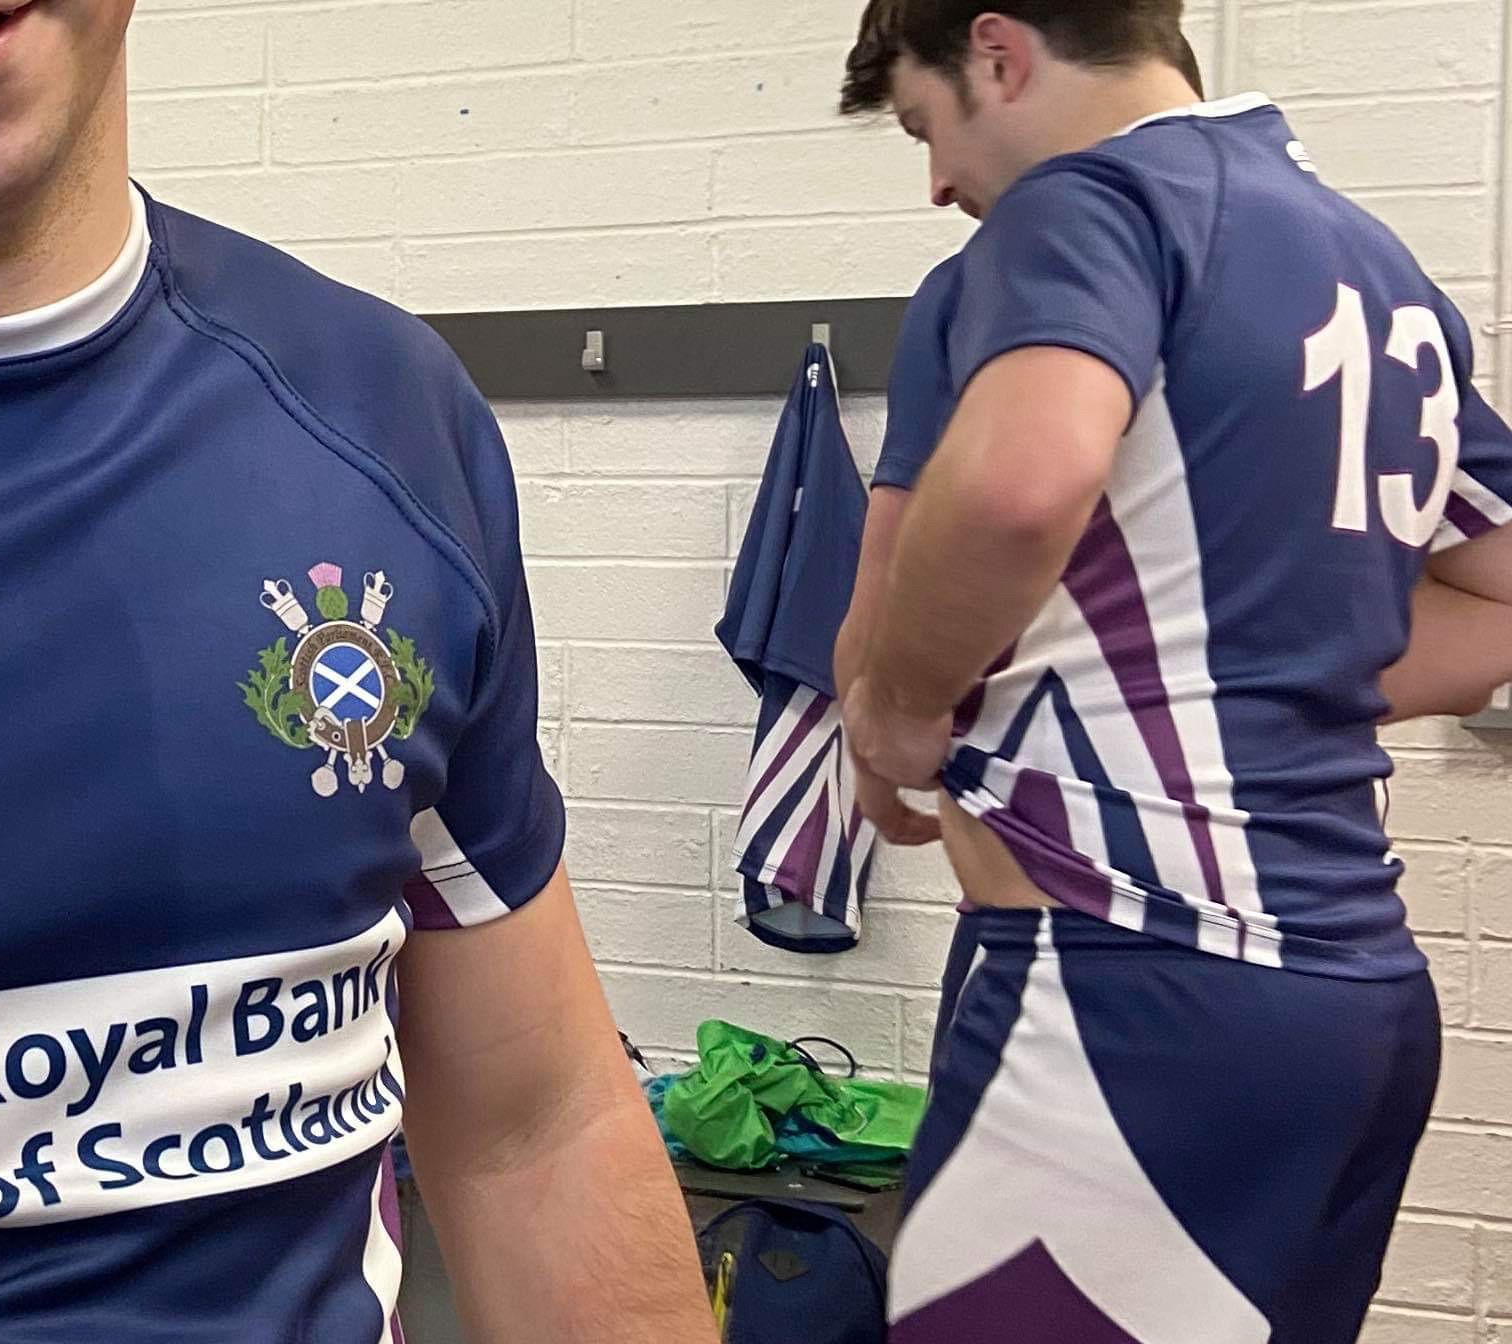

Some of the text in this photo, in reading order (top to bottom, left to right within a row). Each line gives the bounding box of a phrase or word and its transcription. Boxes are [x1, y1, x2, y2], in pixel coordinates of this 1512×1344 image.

[1303, 282, 1459, 547] 13
[232, 939, 390, 1057] Bank
[76, 1035, 403, 1191] Scotland
